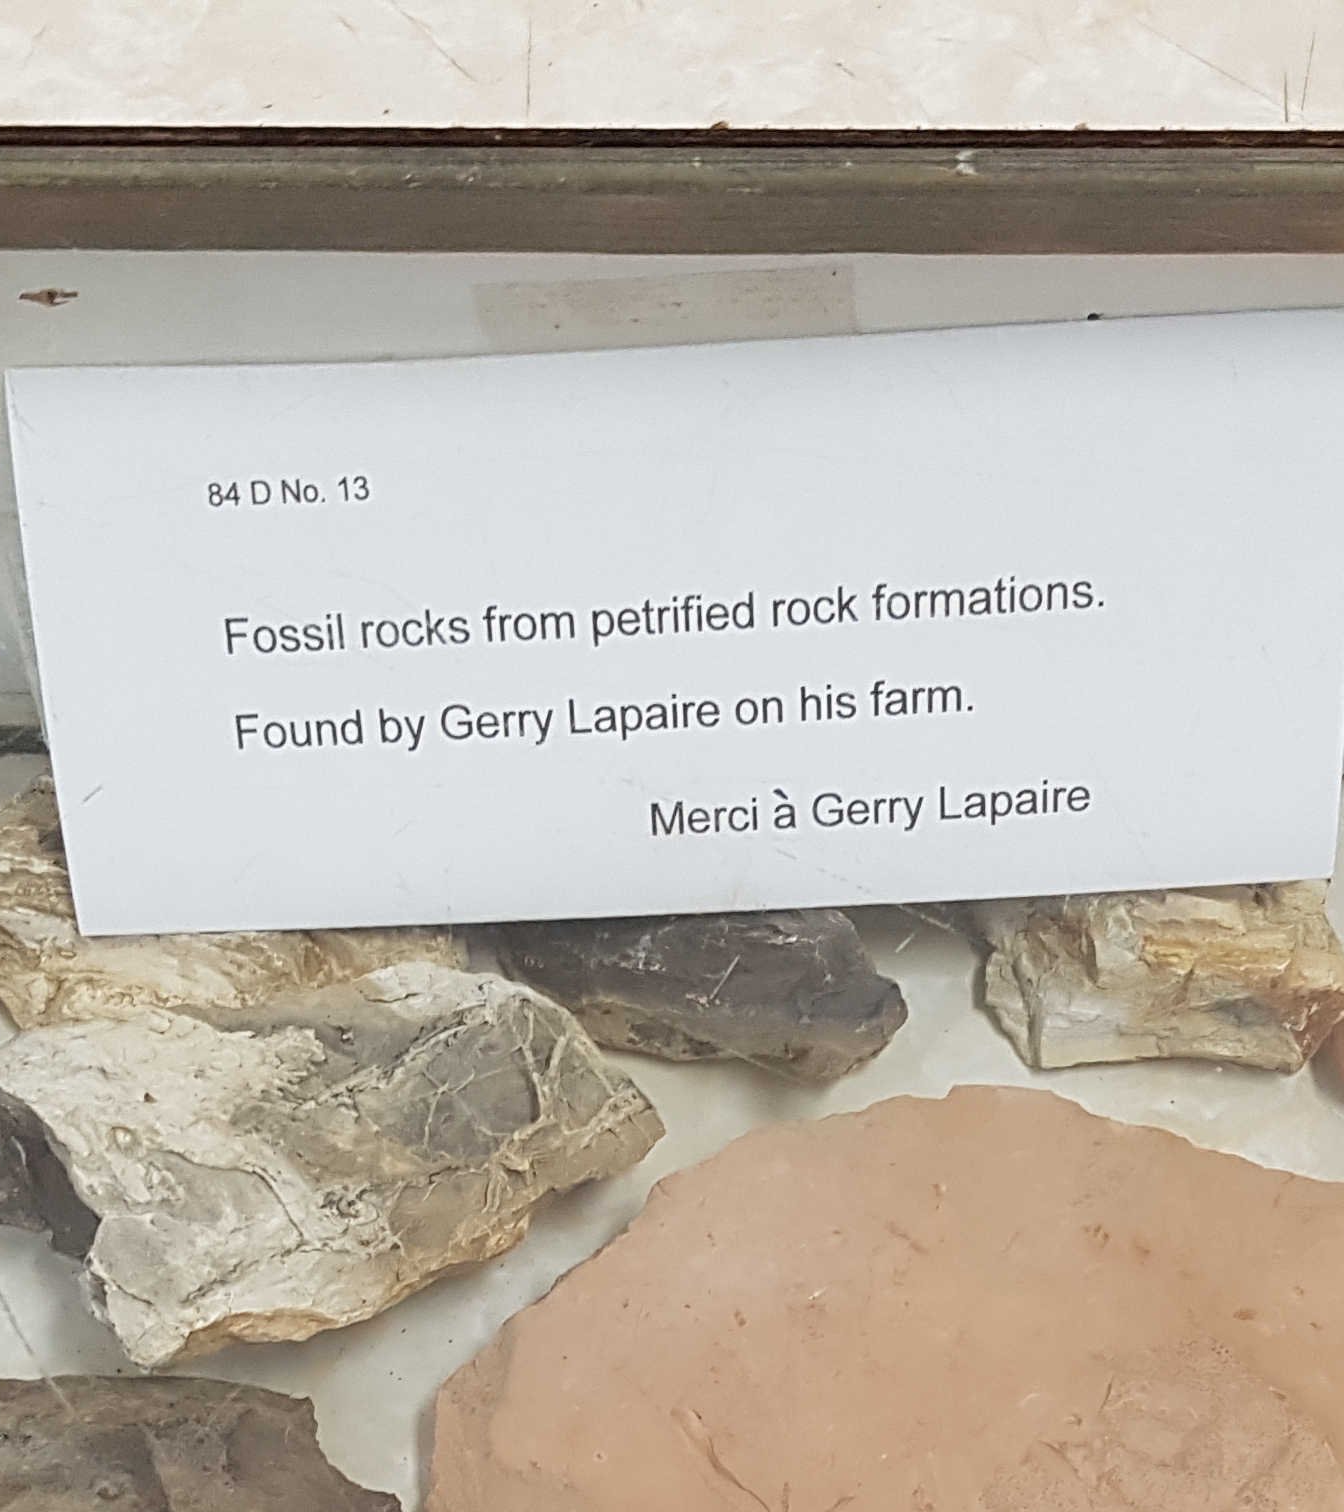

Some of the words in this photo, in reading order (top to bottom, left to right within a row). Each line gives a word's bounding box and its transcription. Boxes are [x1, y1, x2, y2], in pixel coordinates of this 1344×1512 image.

[207, 481, 241, 508] 84
[250, 479, 272, 506] D
[280, 478, 326, 505] No.
[337, 475, 370, 502] 13
[224, 612, 346, 655] Fossil
[360, 608, 471, 649] rocks
[481, 604, 576, 643] from
[591, 591, 755, 648] petrified
[772, 585, 859, 628] rock
[871, 575, 1105, 621] formations.
[234, 708, 364, 750] Found
[378, 707, 426, 752] by
[440, 703, 554, 746] Gerry
[568, 693, 721, 742] Lapaire
[734, 696, 784, 726] on
[799, 683, 857, 722] his
[869, 679, 974, 717] farm.
[650, 796, 759, 837] Merci
[772, 787, 797, 830] à
[811, 792, 925, 832] Gerry
[939, 778, 1091, 826] Lapaire
